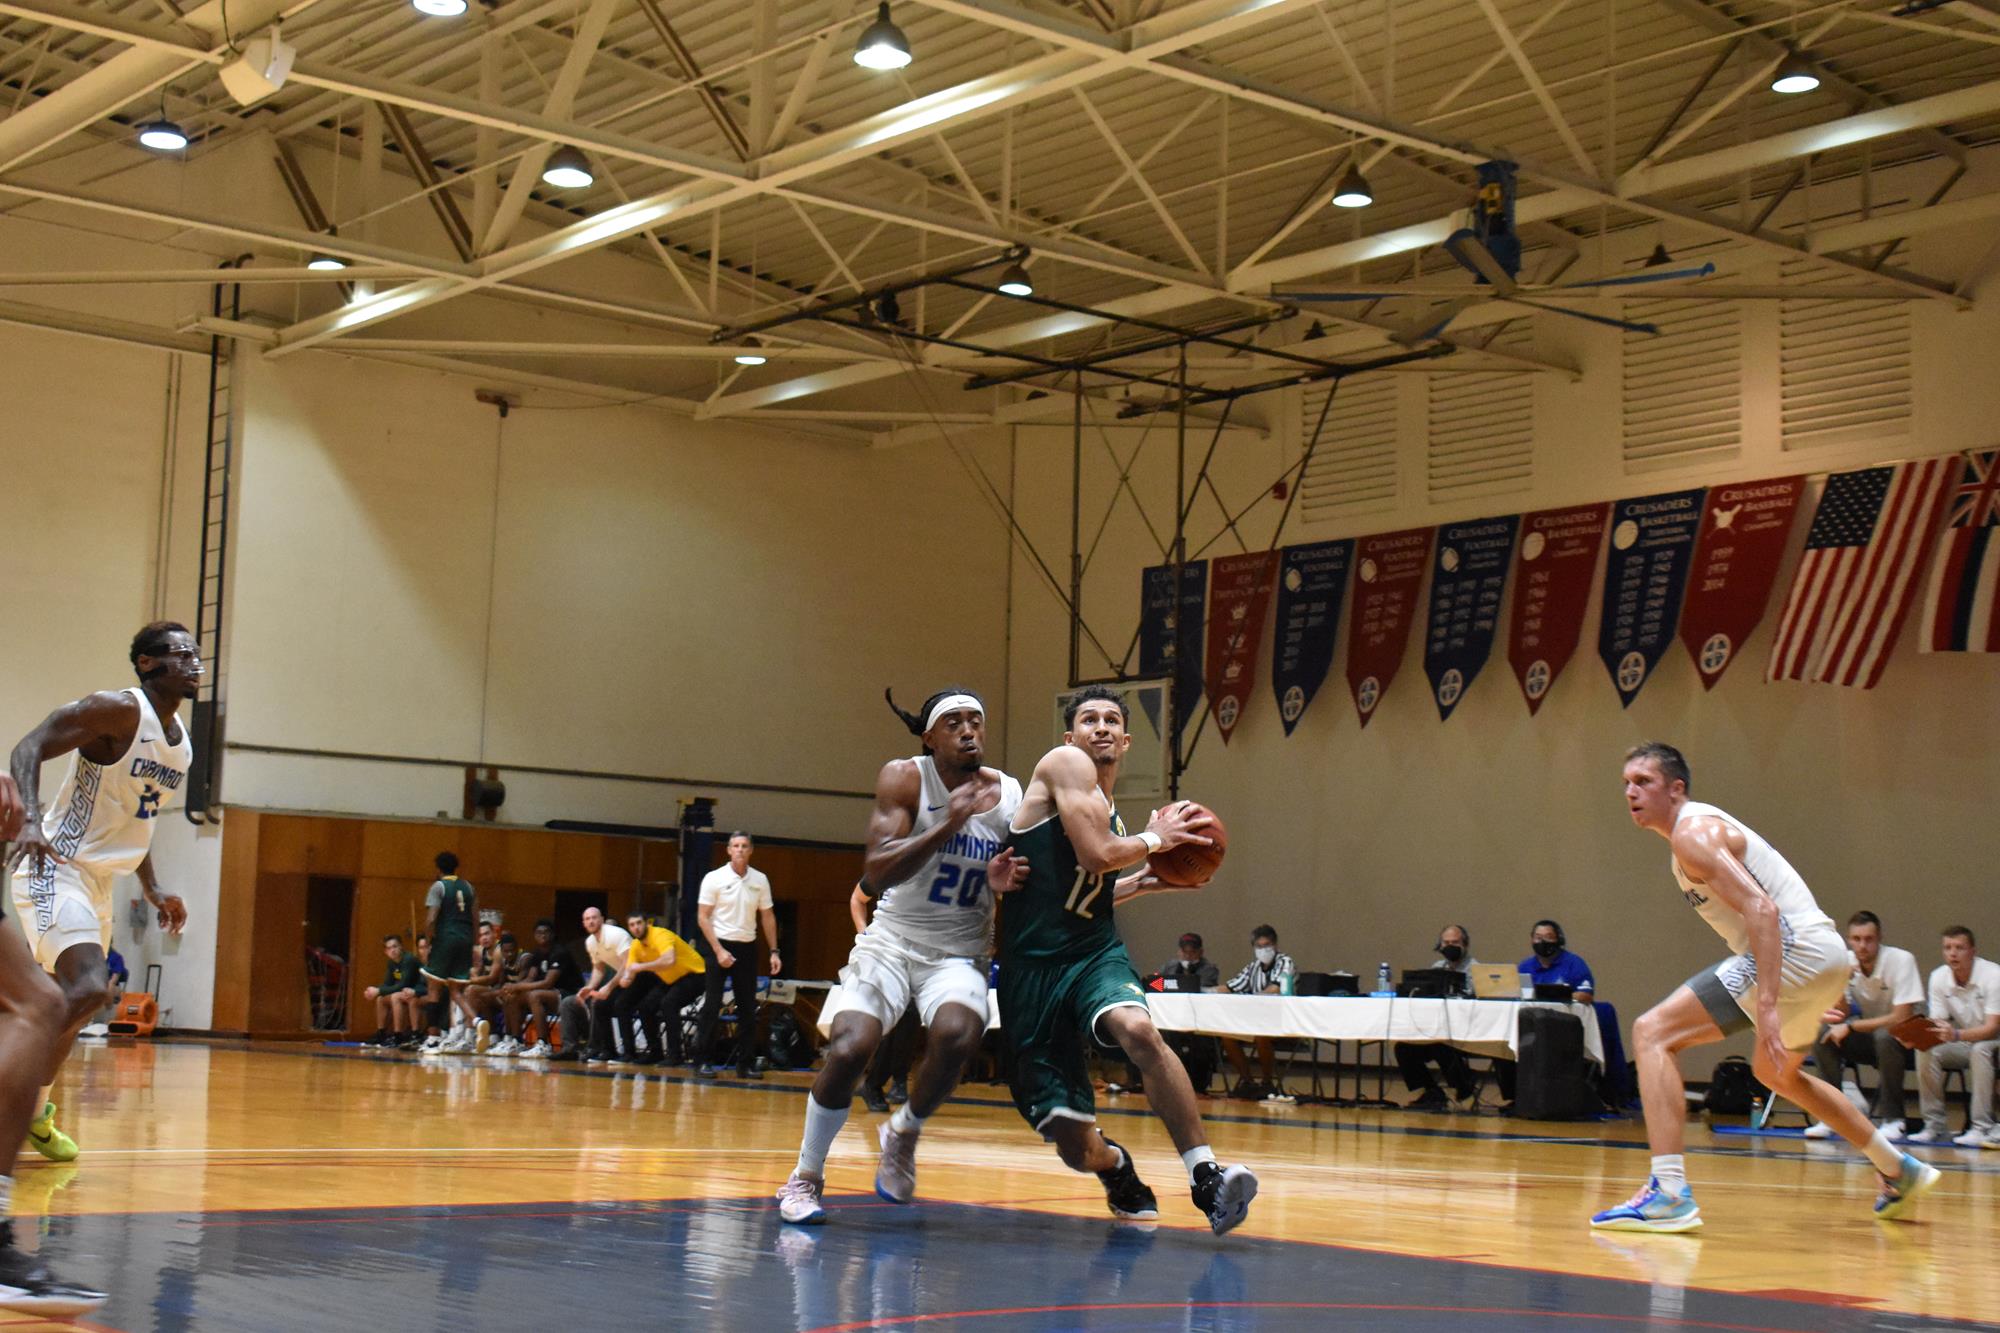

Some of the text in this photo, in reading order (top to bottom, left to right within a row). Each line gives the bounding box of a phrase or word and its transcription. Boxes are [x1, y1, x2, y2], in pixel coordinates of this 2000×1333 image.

[1720, 483, 1793, 502] CRUSADERS
[1625, 498, 1694, 516] CRUSADERS
[1743, 498, 1793, 512] BASEBALL
[1534, 511, 1599, 529] CRUSADERS
[1640, 511, 1699, 528] BASKETBALL
[1448, 524, 1508, 540] CRUSADERS
[1548, 524, 1603, 539] BASKETBALL
[1368, 536, 1424, 552] CRUSADERS
[1464, 538, 1509, 551] FOOTBALL
[1290, 546, 1344, 561] CRUSADERS
[1303, 560, 1343, 573] FOOTBALL
[927, 863, 986, 907] 20
[1064, 865, 1104, 919] 12
